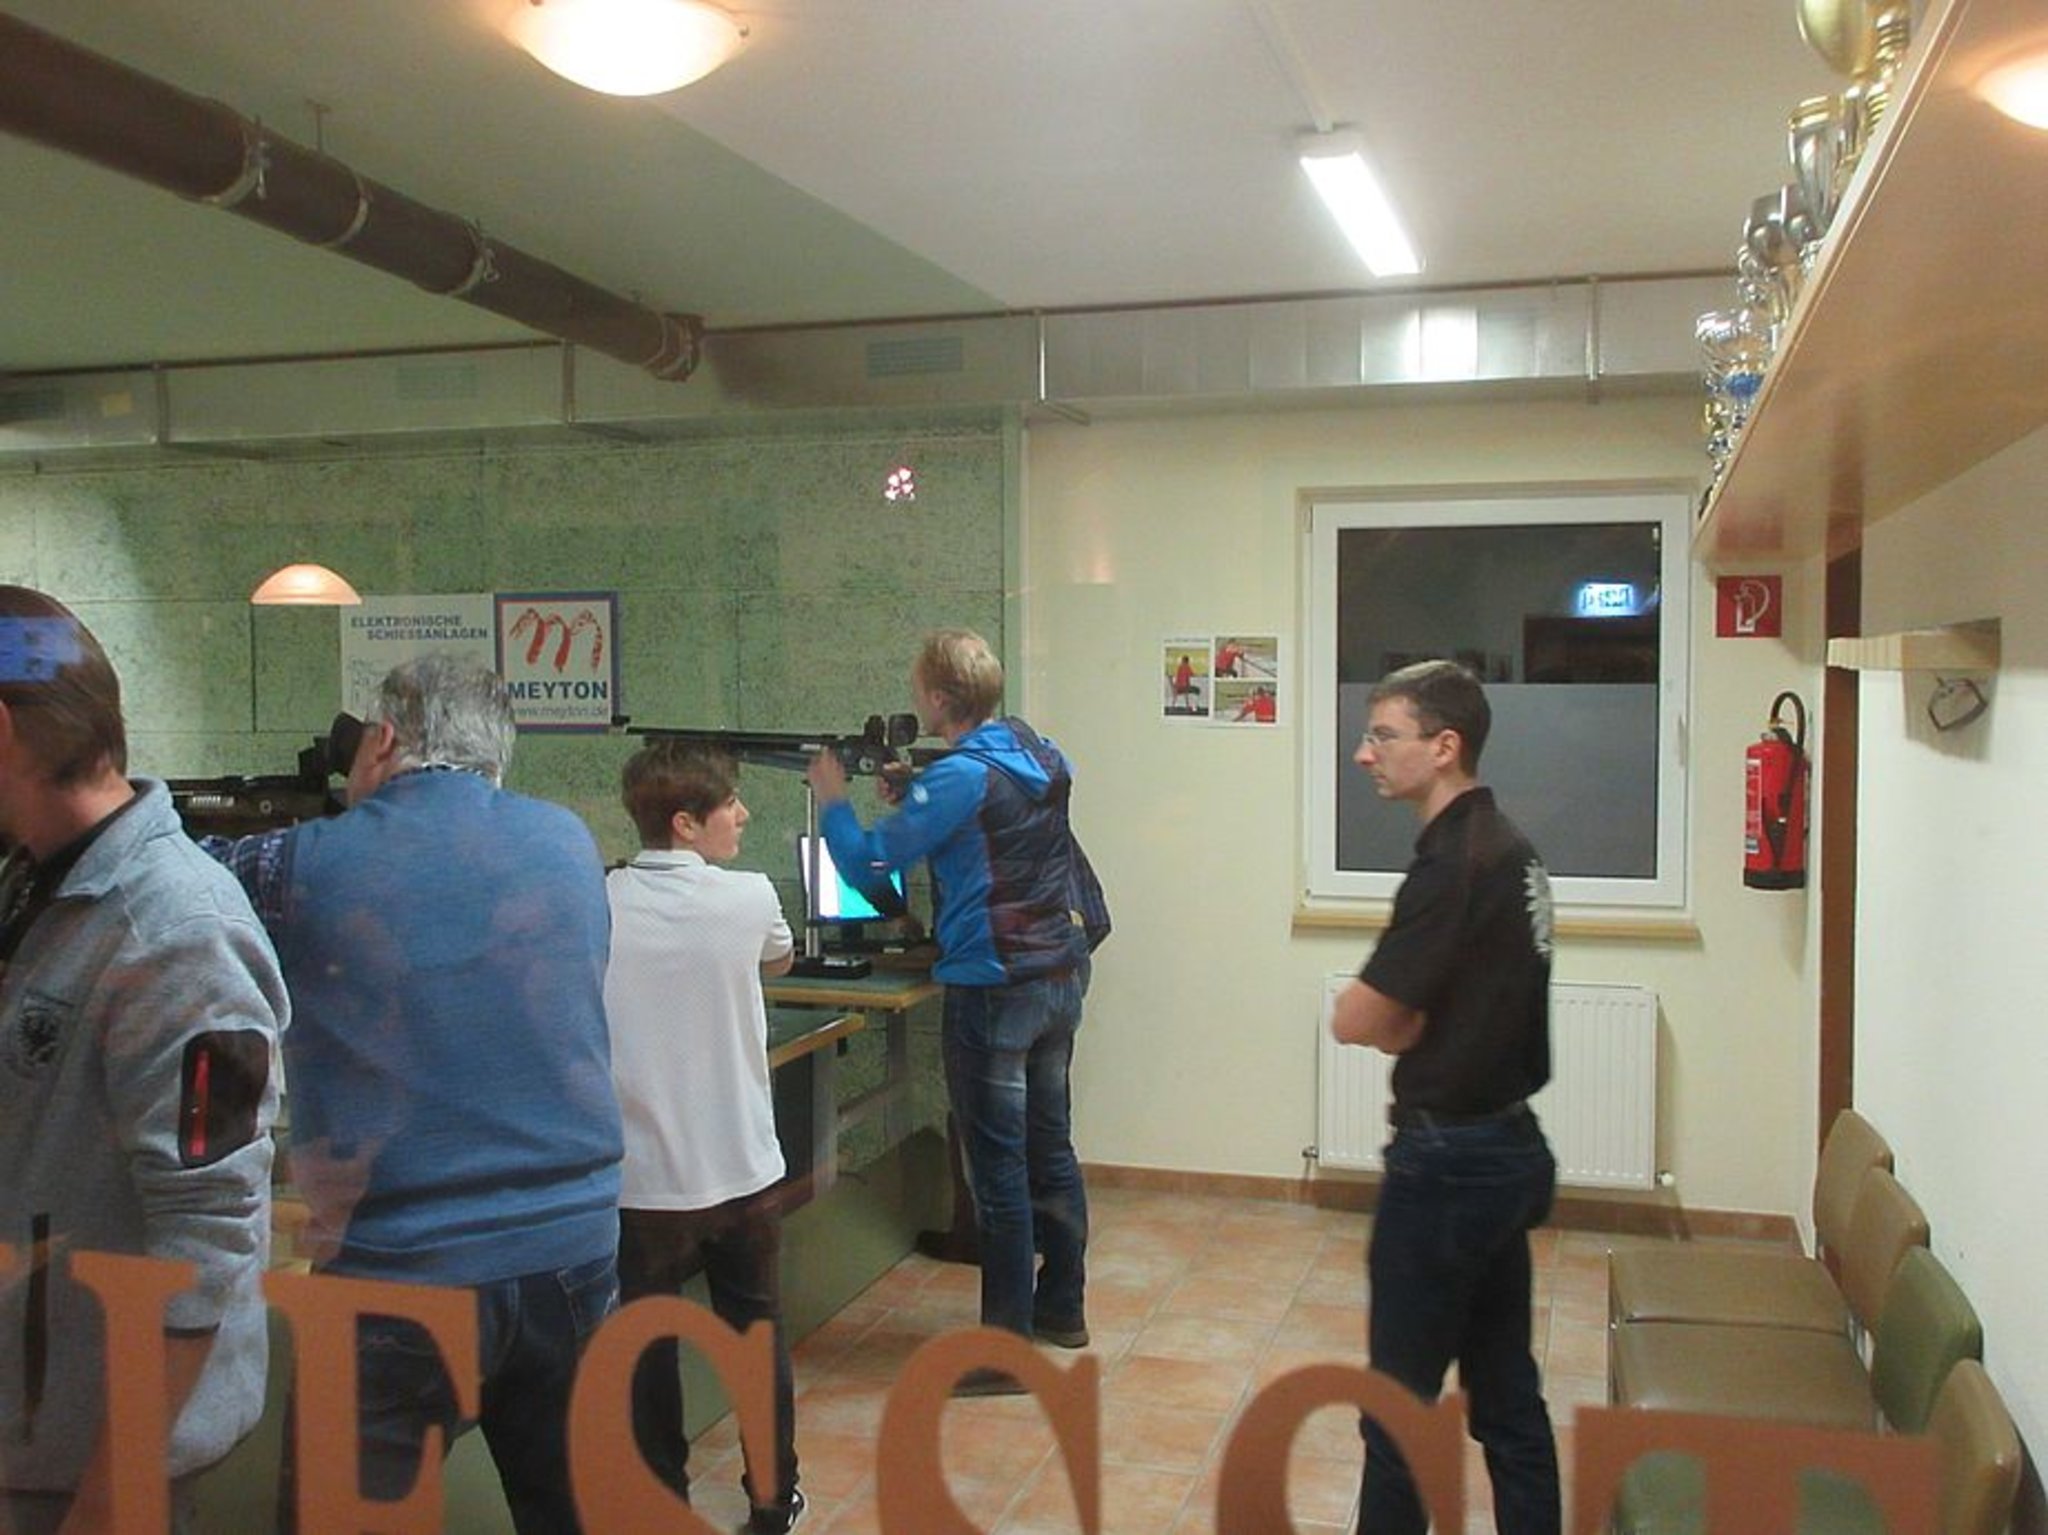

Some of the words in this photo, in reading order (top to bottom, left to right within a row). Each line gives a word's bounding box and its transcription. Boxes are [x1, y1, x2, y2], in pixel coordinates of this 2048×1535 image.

[351, 614, 462, 628] ELEKTRONISCHE
[367, 627, 488, 641] SCHIESSANLAGEN
[507, 680, 607, 699] MEYTON
